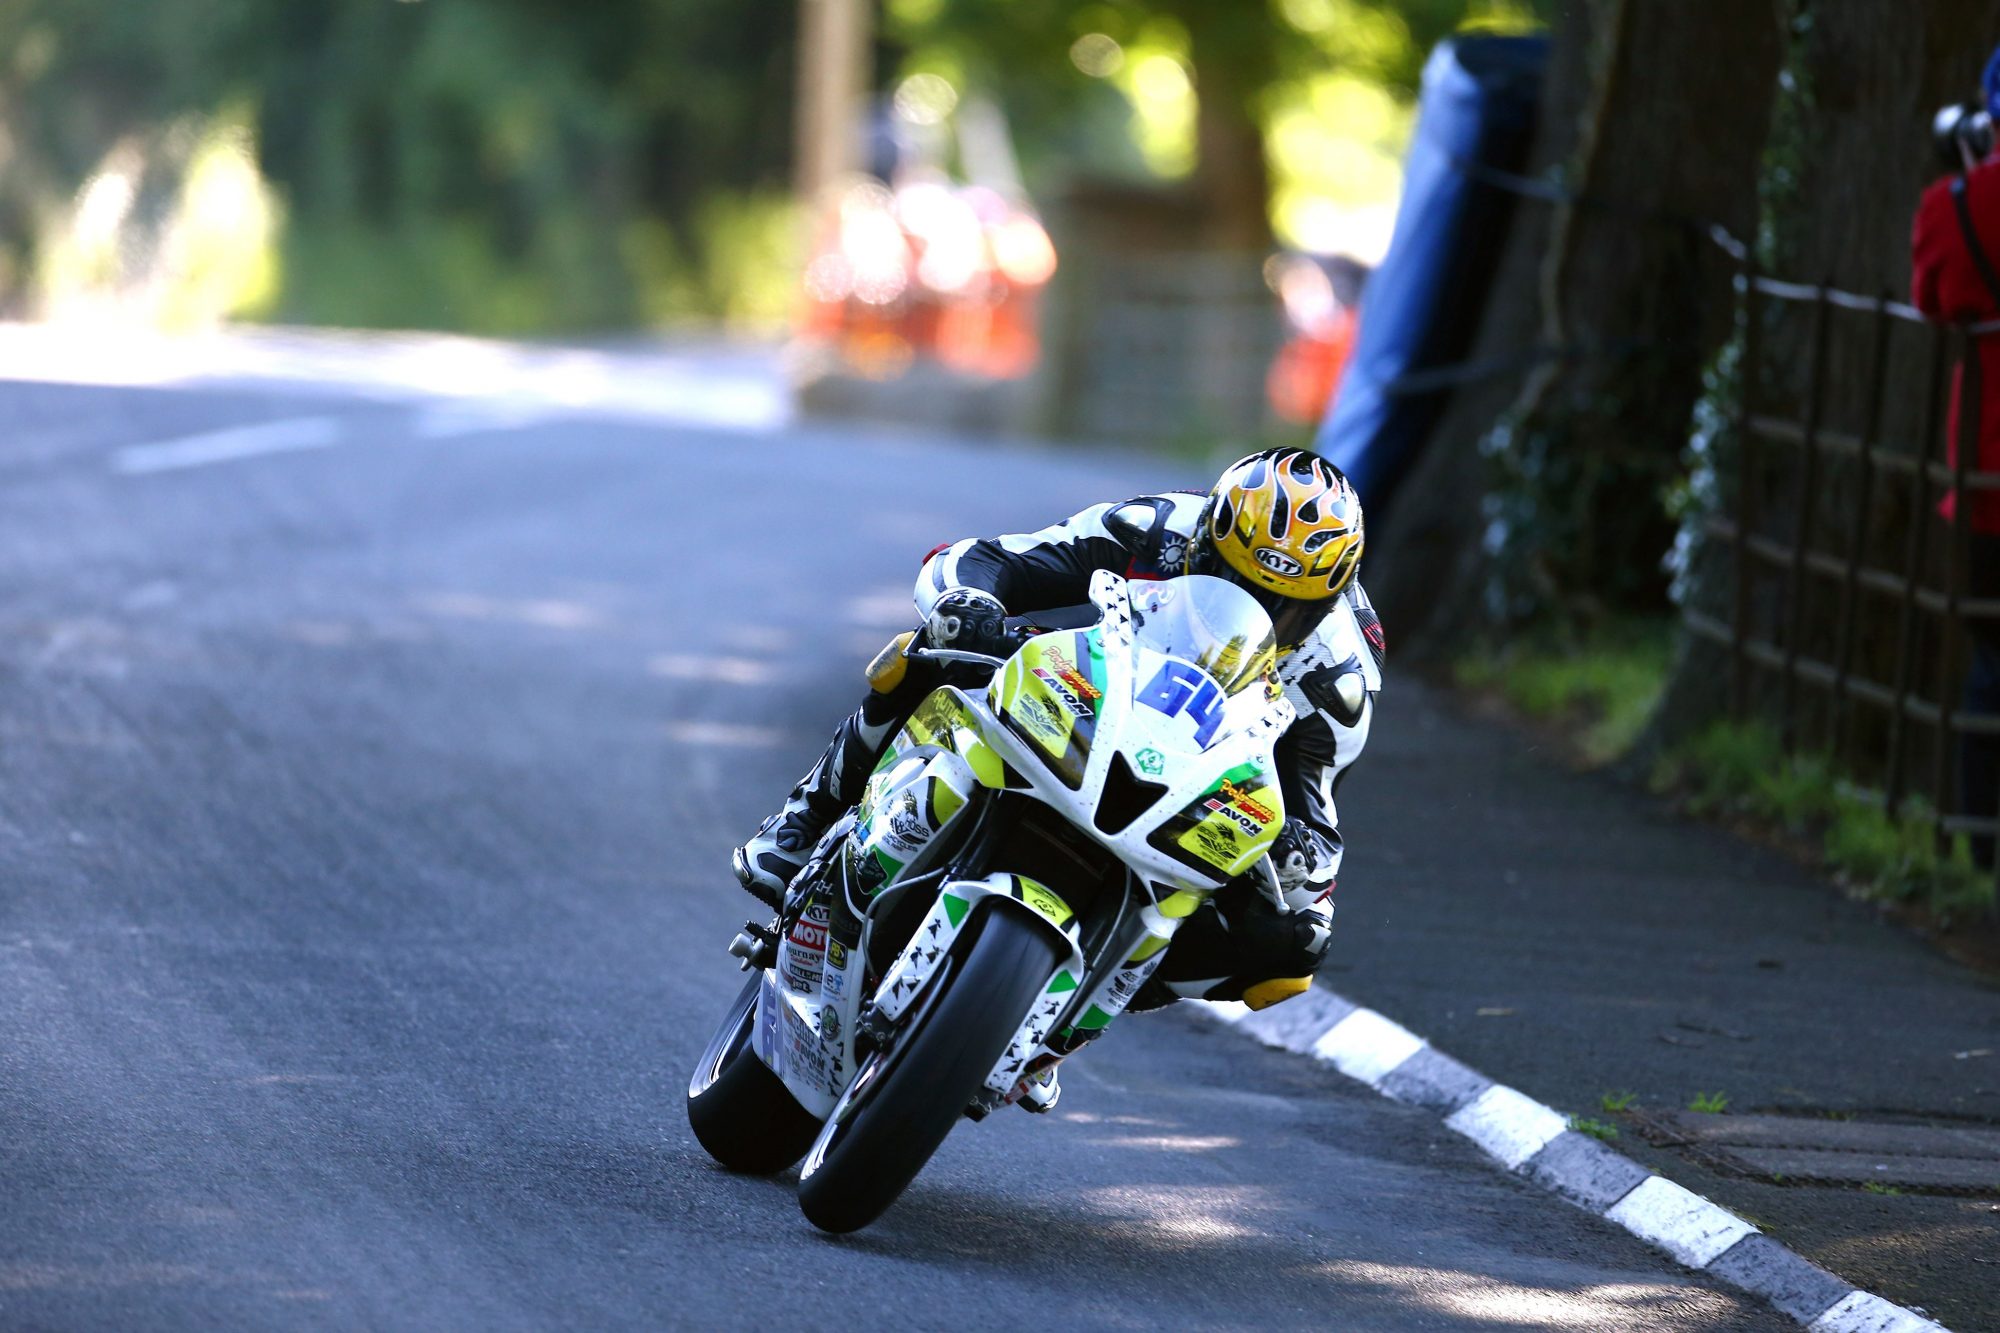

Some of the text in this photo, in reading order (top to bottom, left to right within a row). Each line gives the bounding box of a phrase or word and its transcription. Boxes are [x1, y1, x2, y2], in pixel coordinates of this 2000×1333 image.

[1257, 550, 1299, 574] KYT
[1043, 678, 1094, 716] AVON
[1135, 660, 1224, 750] 64
[904, 820, 930, 837] HOSS
[1219, 806, 1263, 834] AVON
[793, 923, 828, 945] MOT
